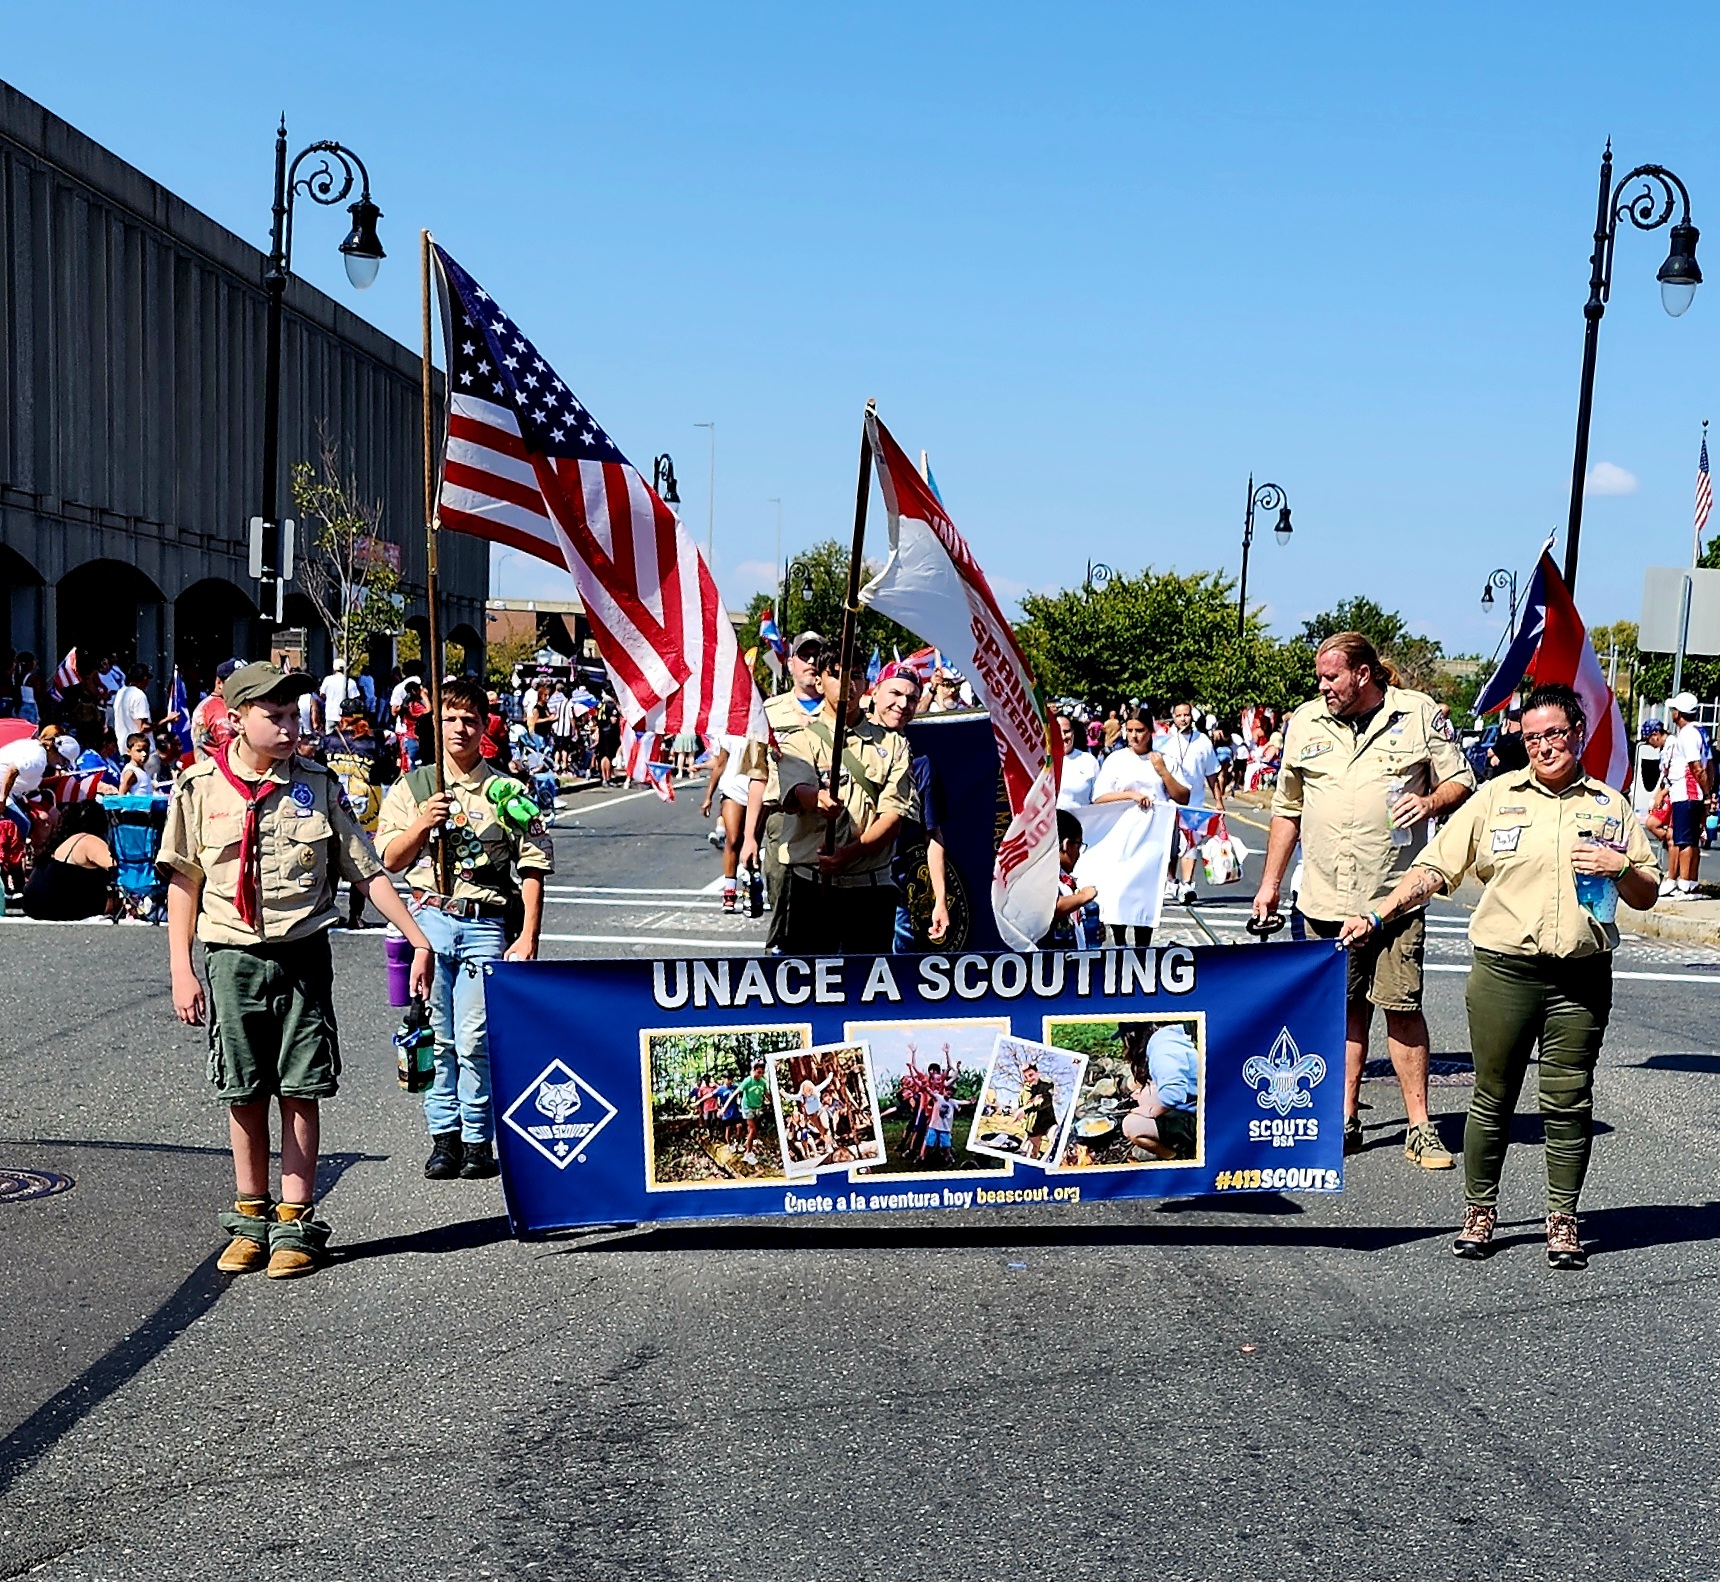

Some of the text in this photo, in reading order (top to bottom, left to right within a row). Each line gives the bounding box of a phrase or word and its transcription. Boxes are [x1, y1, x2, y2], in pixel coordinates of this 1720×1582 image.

[970, 614, 1046, 750] SPRING
[972, 647, 1038, 753] WESTERN
[653, 947, 1195, 1010] UNACE A SCOUTING
[551, 1122, 595, 1139] SCOUTS
[1248, 1118, 1319, 1137] SCOUTS
[1272, 1135, 1295, 1148] BSA
[1214, 1167, 1340, 1190] #413SCOUTS
[836, 1196, 847, 1212] a
[850, 1191, 866, 1211] la
[869, 1190, 940, 1210] aventura
[943, 1187, 974, 1209] hoy
[976, 1186, 1080, 1205] beascout.org
